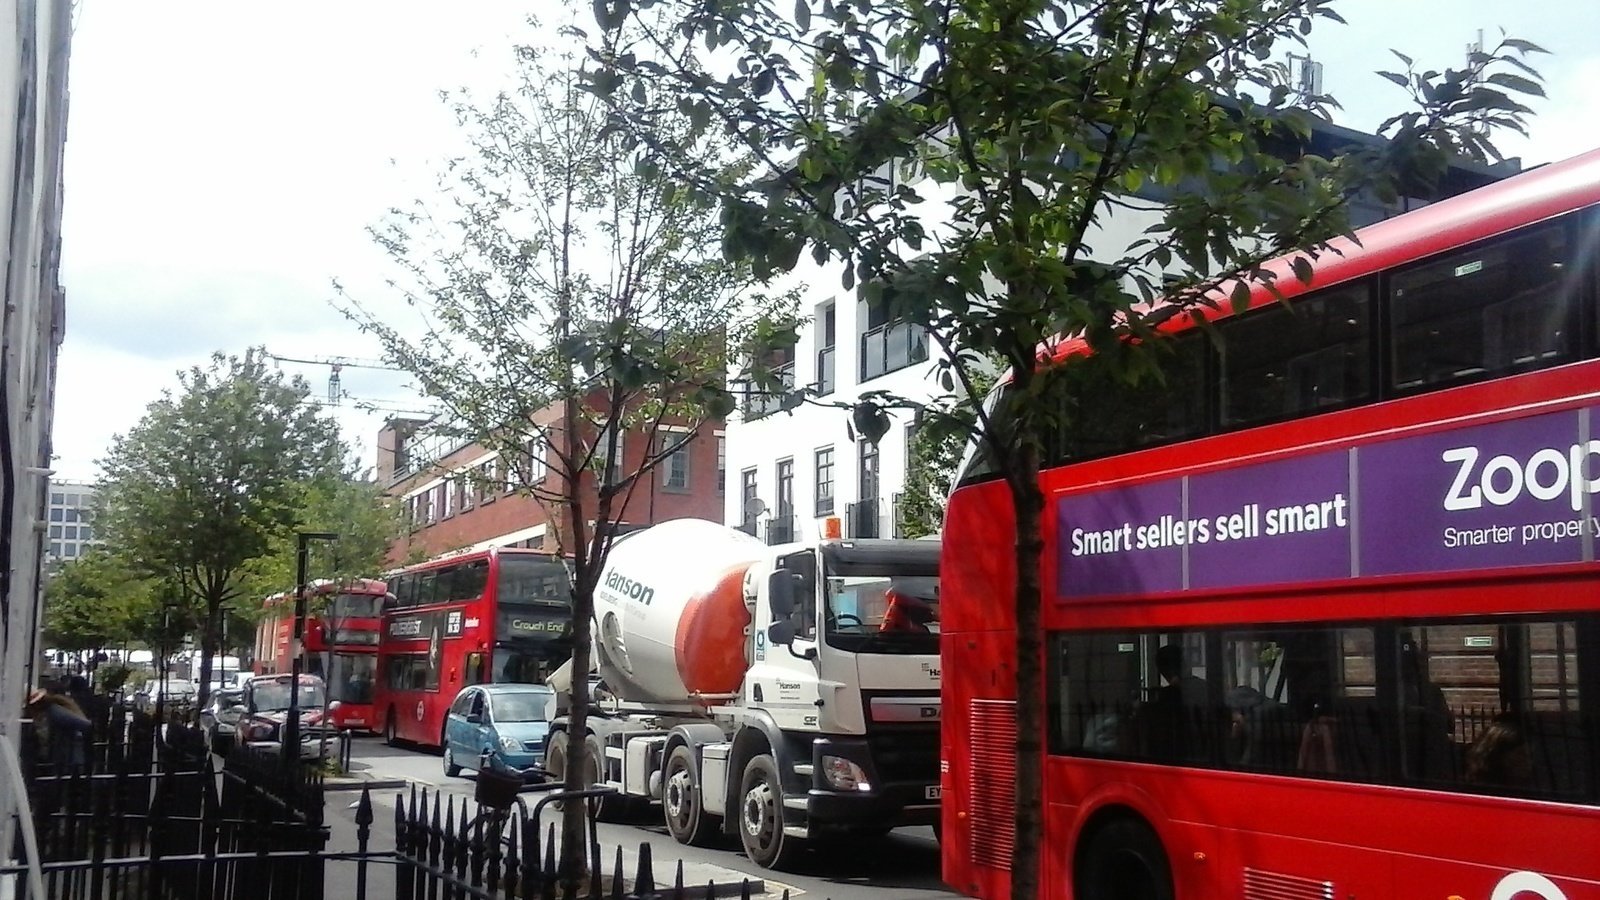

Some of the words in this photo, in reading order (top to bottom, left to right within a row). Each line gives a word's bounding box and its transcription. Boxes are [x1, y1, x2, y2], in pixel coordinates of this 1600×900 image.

[1071, 522, 1132, 556] Smart
[1136, 515, 1210, 550] sellers
[1215, 504, 1259, 542] sell
[1265, 493, 1347, 536] smart
[1444, 524, 1516, 548] Smarter
[512, 619, 545, 631] Crouch
[547, 621, 565, 632] End
